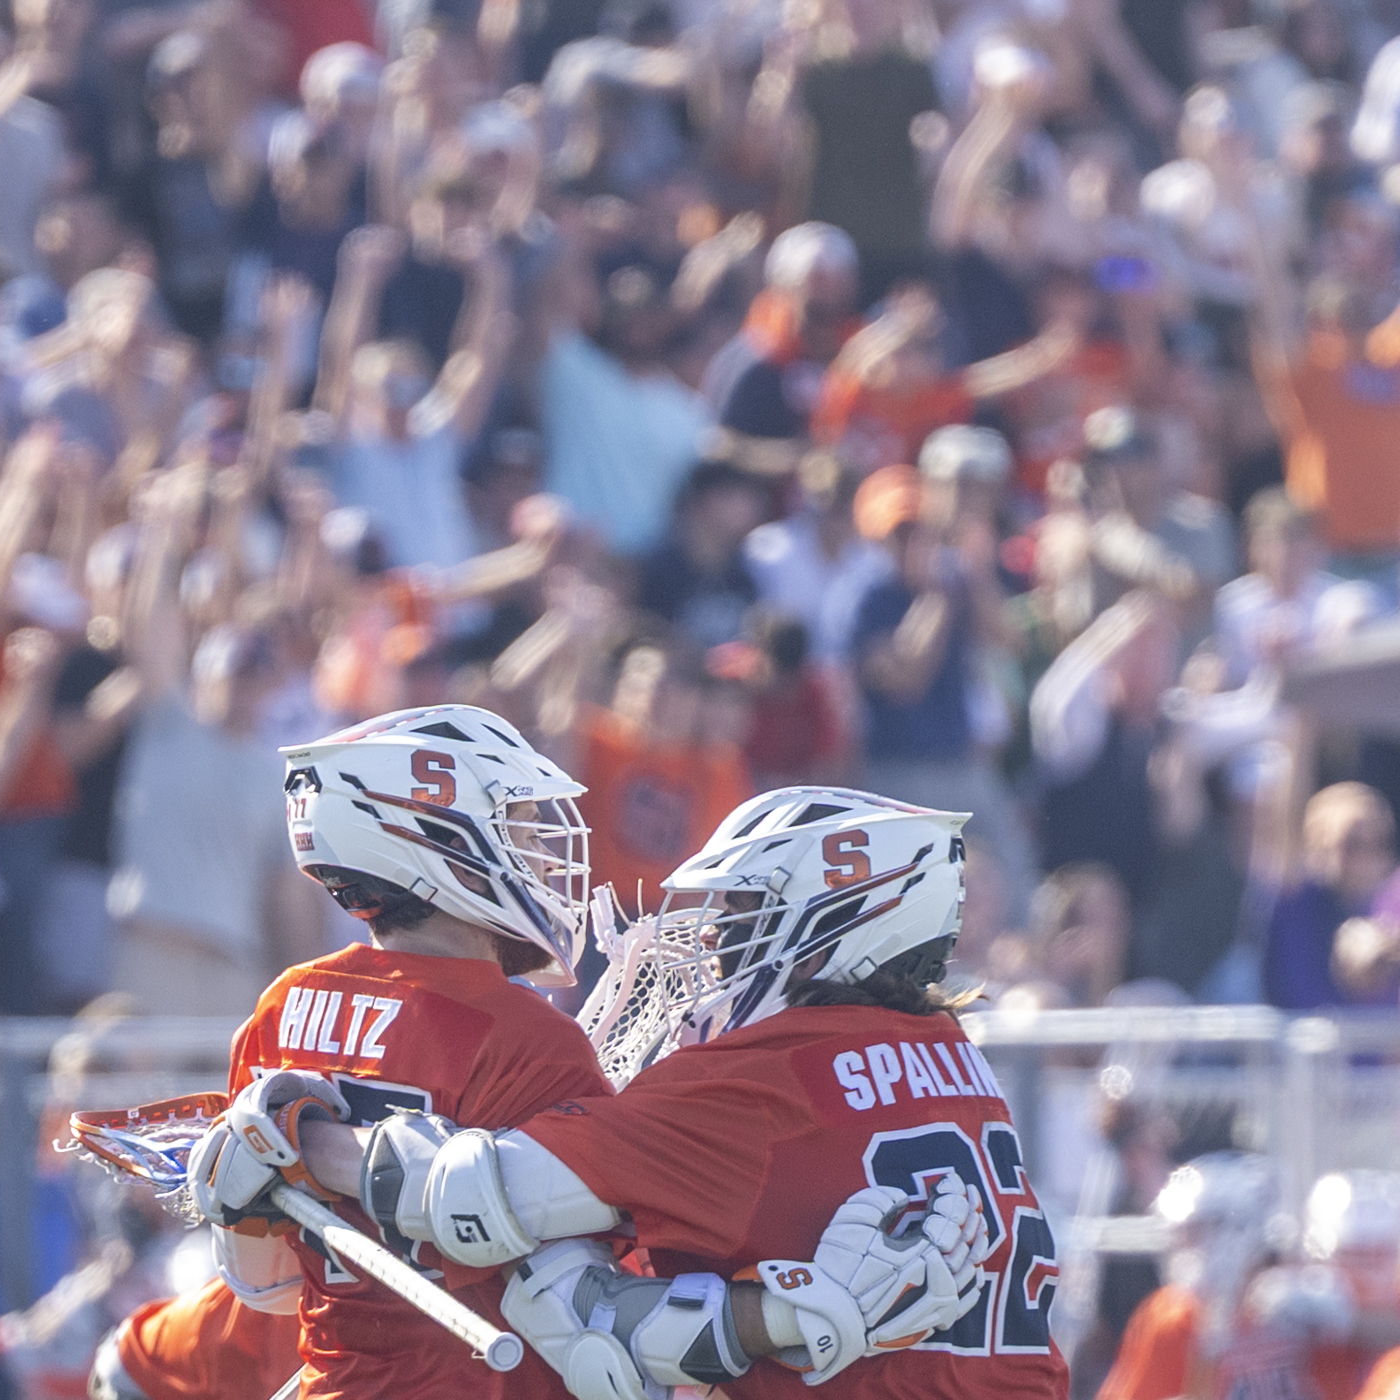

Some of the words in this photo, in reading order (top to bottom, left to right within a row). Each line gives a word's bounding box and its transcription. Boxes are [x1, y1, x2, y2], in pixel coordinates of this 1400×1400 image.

[410, 748, 456, 808] S
[821, 828, 872, 890] S
[278, 986, 403, 1059] HILTZ
[775, 1266, 814, 1291] S
[816, 1334, 834, 1354] 10
